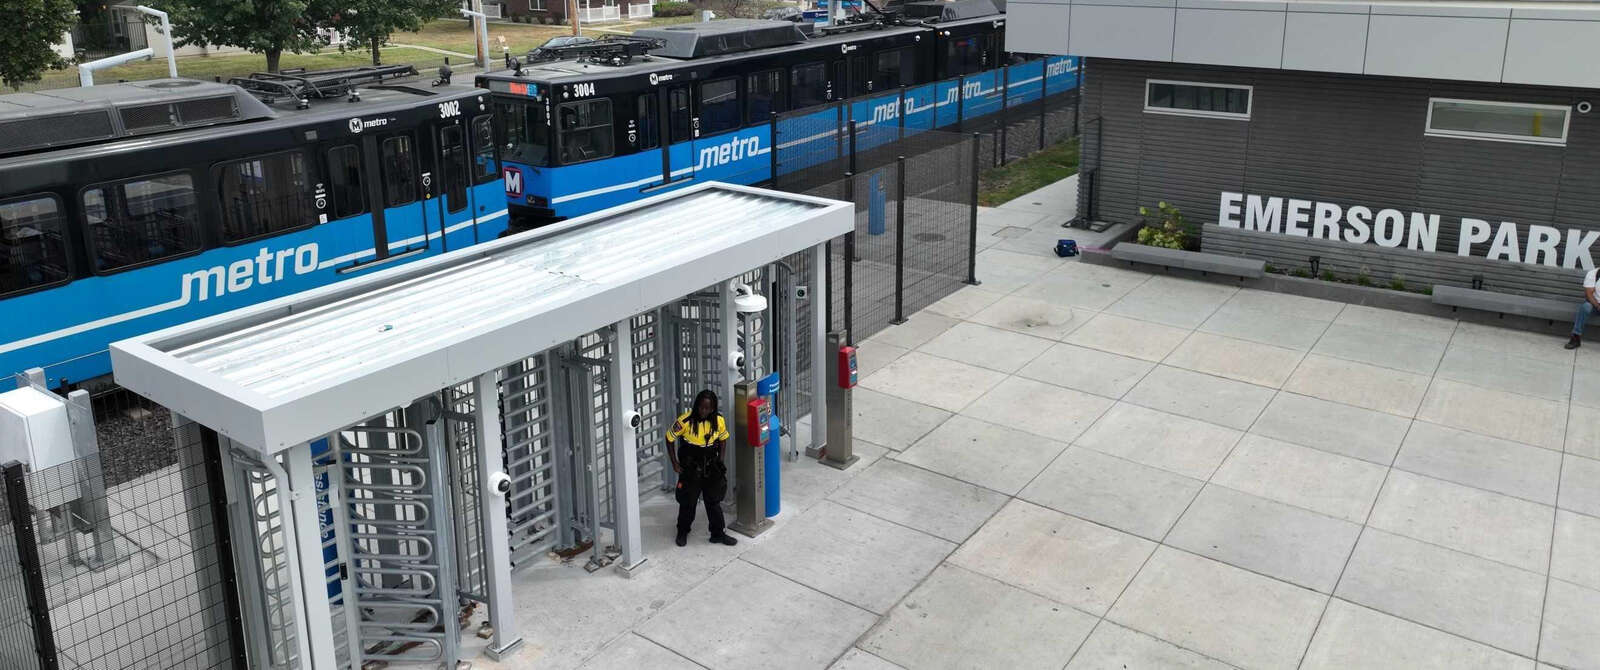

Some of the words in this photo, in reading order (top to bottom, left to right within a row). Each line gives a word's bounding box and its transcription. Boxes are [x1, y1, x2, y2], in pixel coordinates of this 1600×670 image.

[1045, 58, 1073, 78] metro
[573, 82, 596, 98] 3004
[439, 100, 461, 119] 3002
[873, 97, 915, 122] meto
[364, 118, 388, 129] metro
[701, 135, 760, 169] metro
[505, 170, 520, 194] M
[1218, 191, 1441, 252] EMERSON
[1457, 217, 1600, 270] PARK
[180, 242, 319, 305] metro
